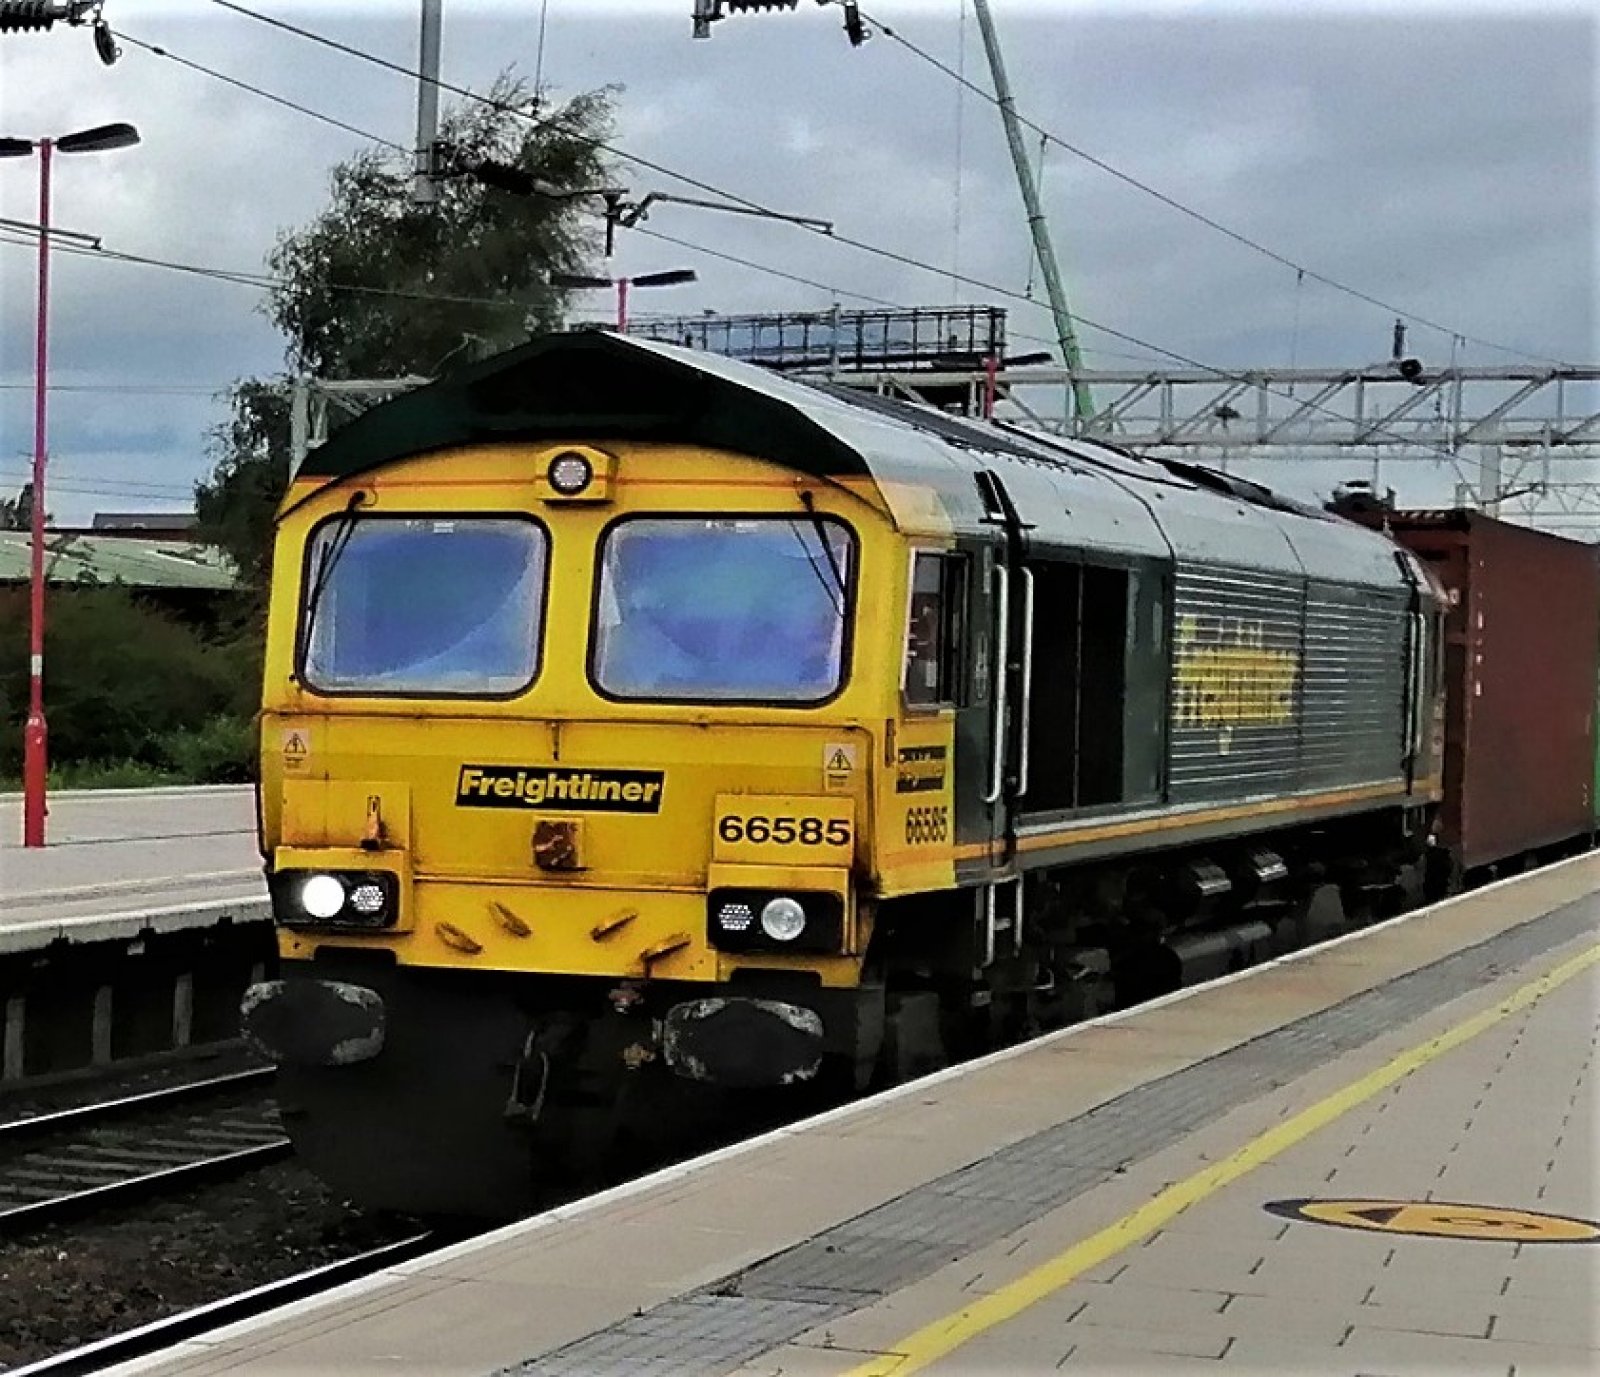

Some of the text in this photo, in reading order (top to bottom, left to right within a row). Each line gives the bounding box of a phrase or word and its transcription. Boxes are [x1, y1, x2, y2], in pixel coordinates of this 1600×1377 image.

[459, 769, 660, 804] Freightliner
[718, 815, 850, 846] 66585
[905, 806, 948, 844] 66585
